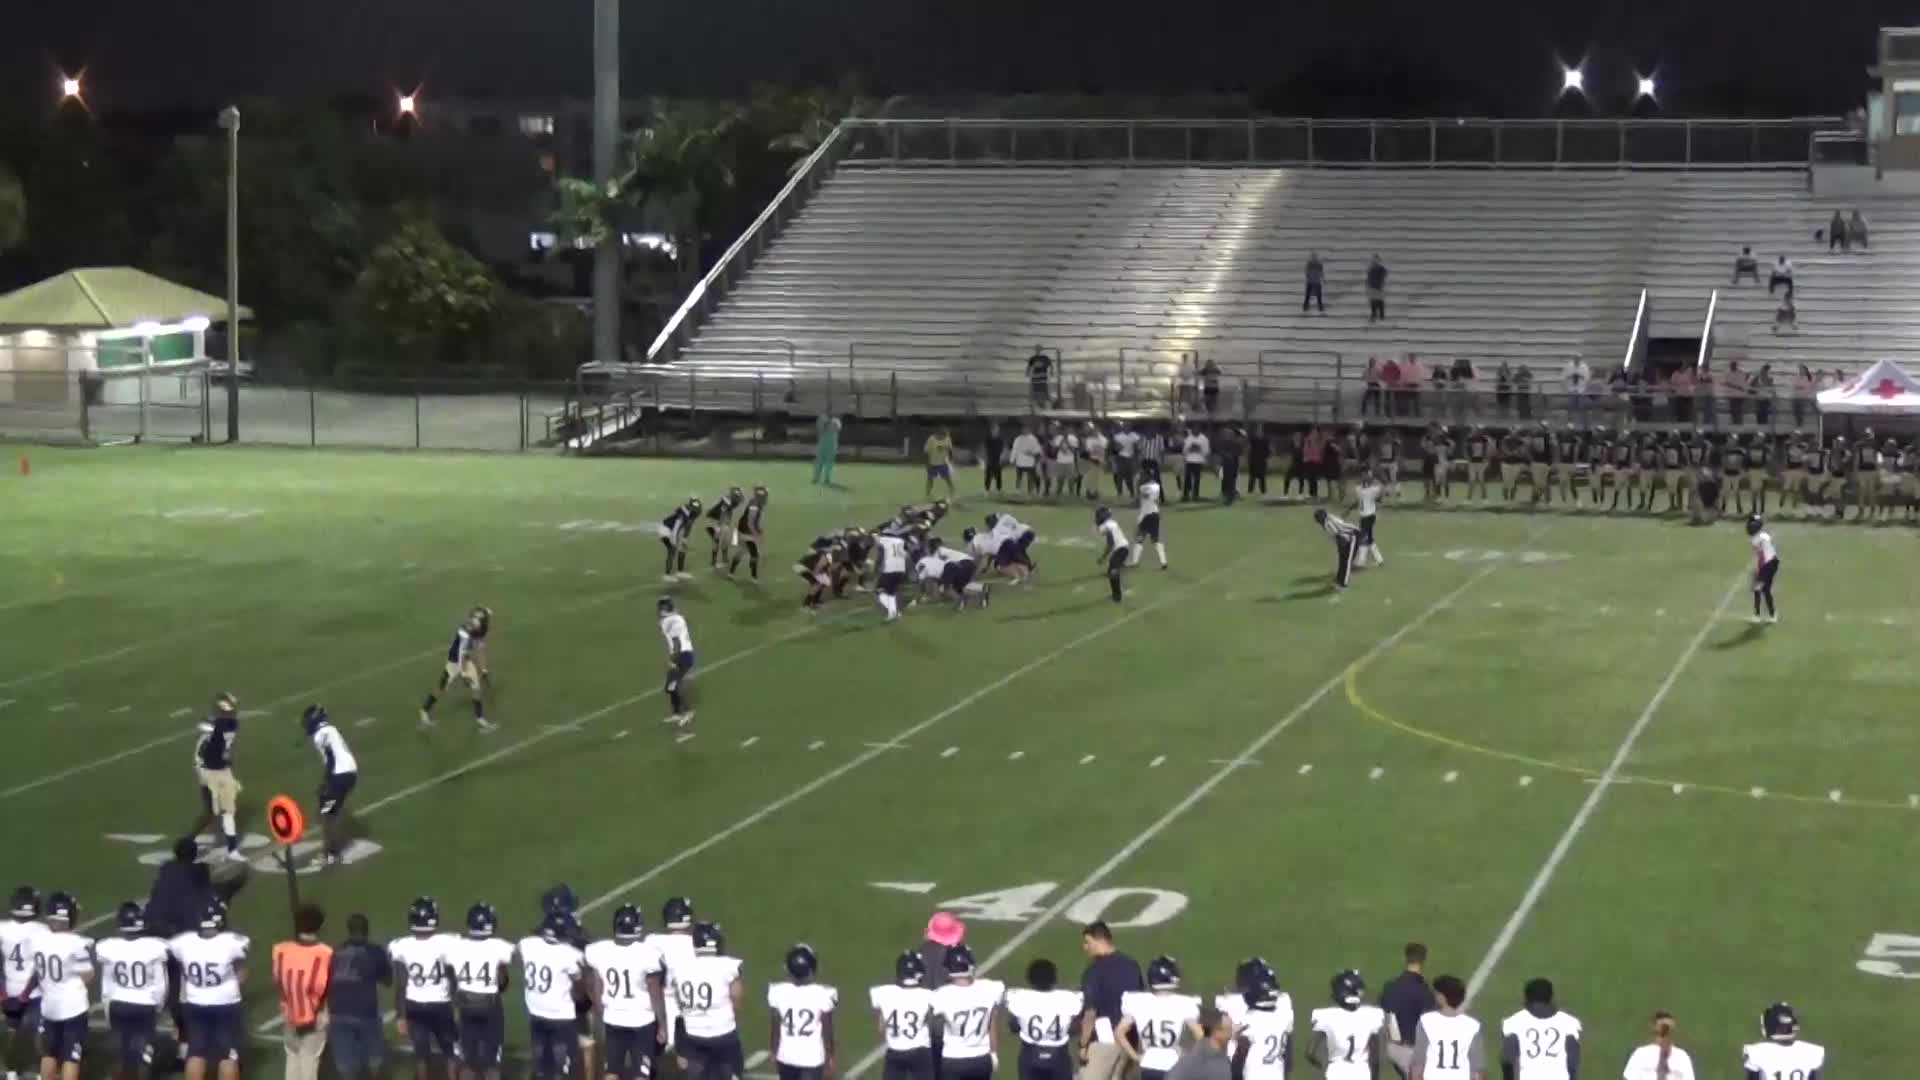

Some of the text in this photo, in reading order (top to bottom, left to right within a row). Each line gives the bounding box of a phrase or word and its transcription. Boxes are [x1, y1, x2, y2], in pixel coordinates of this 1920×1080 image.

[936, 880, 1190, 928] 40
[8, 943, 25, 971] 4
[34, 951, 63, 982] 90
[114, 960, 147, 988] 60
[187, 961, 222, 988] 95
[457, 961, 492, 987] 44
[524, 960, 553, 994] 39
[606, 967, 635, 999] 91
[679, 980, 713, 1012] 99
[783, 1007, 815, 1038] 42
[886, 1008, 919, 1040] 43
[952, 1006, 988, 1038] 77
[1027, 1014, 1064, 1041] 64
[1141, 1018, 1177, 1048] 45
[1343, 1035, 1355, 1063] 1
[1436, 1039, 1460, 1069] 11
[1526, 1027, 1561, 1058] 32
